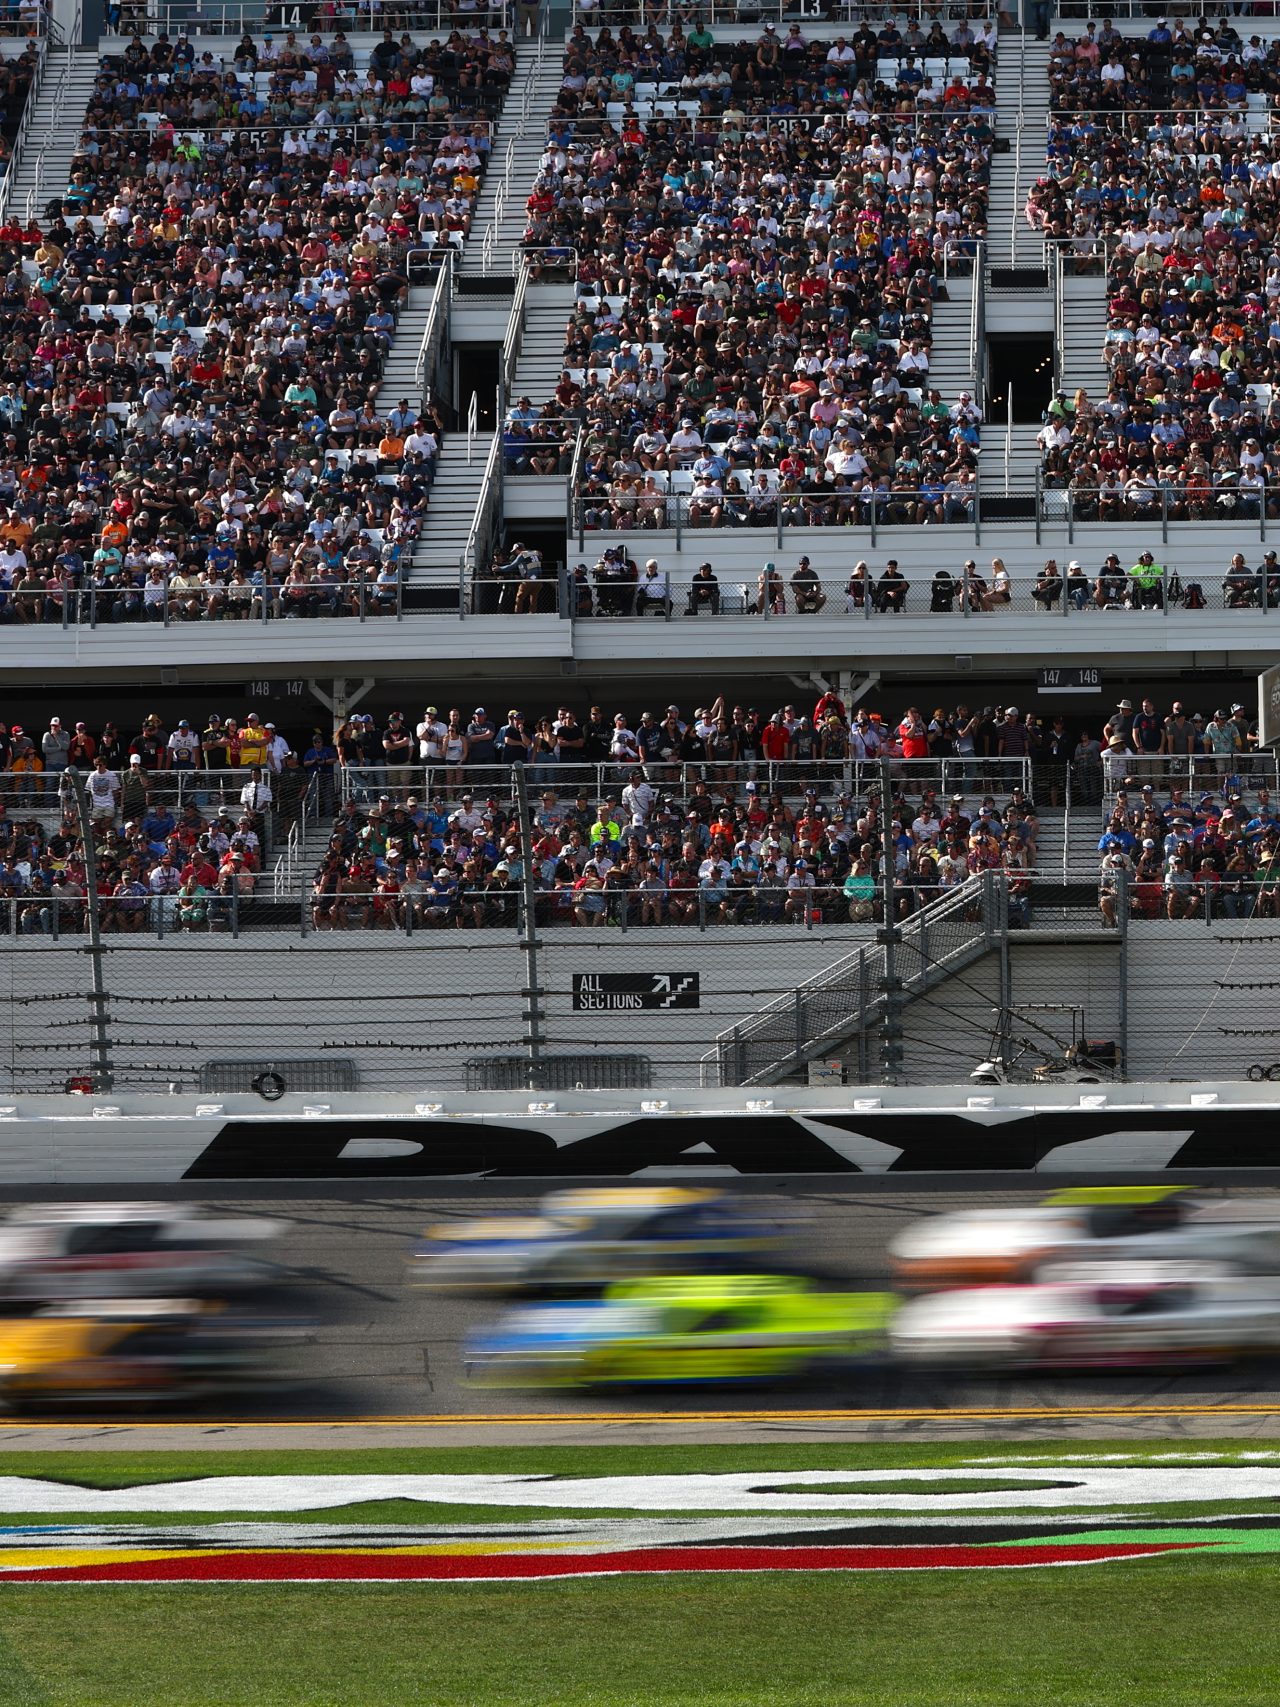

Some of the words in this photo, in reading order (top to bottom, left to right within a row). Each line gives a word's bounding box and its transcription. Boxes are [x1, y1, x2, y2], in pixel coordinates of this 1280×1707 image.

[800, 0, 820, 17] L3
[281, 6, 301, 28] L4
[1043, 670, 1060, 684] 147
[1079, 670, 1098, 684] 146
[251, 681, 270, 696] 148
[286, 681, 303, 696] 147
[579, 975, 603, 992] ALL
[580, 994, 643, 1009] SECTIONS
